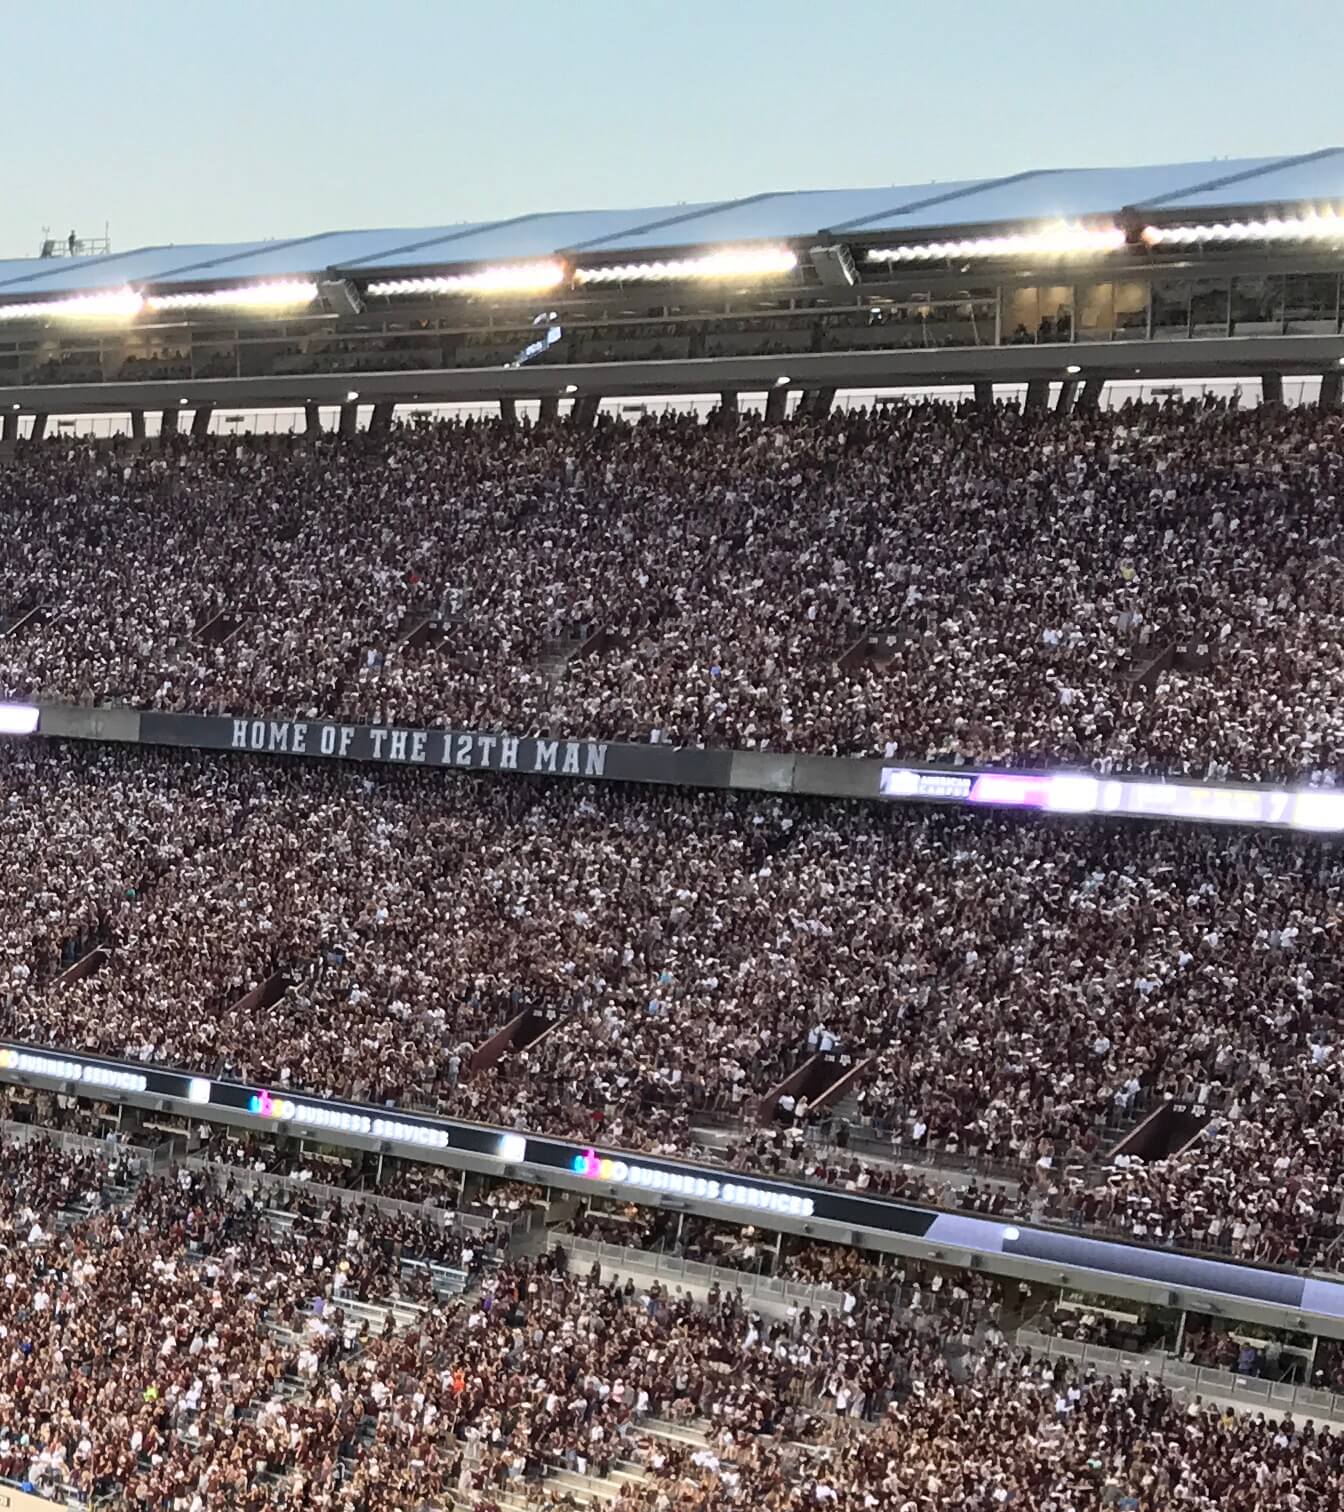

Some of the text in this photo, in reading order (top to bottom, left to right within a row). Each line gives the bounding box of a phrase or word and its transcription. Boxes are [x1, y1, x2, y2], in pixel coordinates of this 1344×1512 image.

[231, 719, 608, 776] HOME OF THE 12TH MAN
[18, 1054, 82, 1080] BUSINESS
[83, 1065, 147, 1092] SERVICES
[295, 1104, 371, 1133] BUSINESS
[373, 1118, 449, 1148] SERVICES
[627, 1166, 720, 1200] BUSINESS
[721, 1183, 814, 1217] SERVICES
